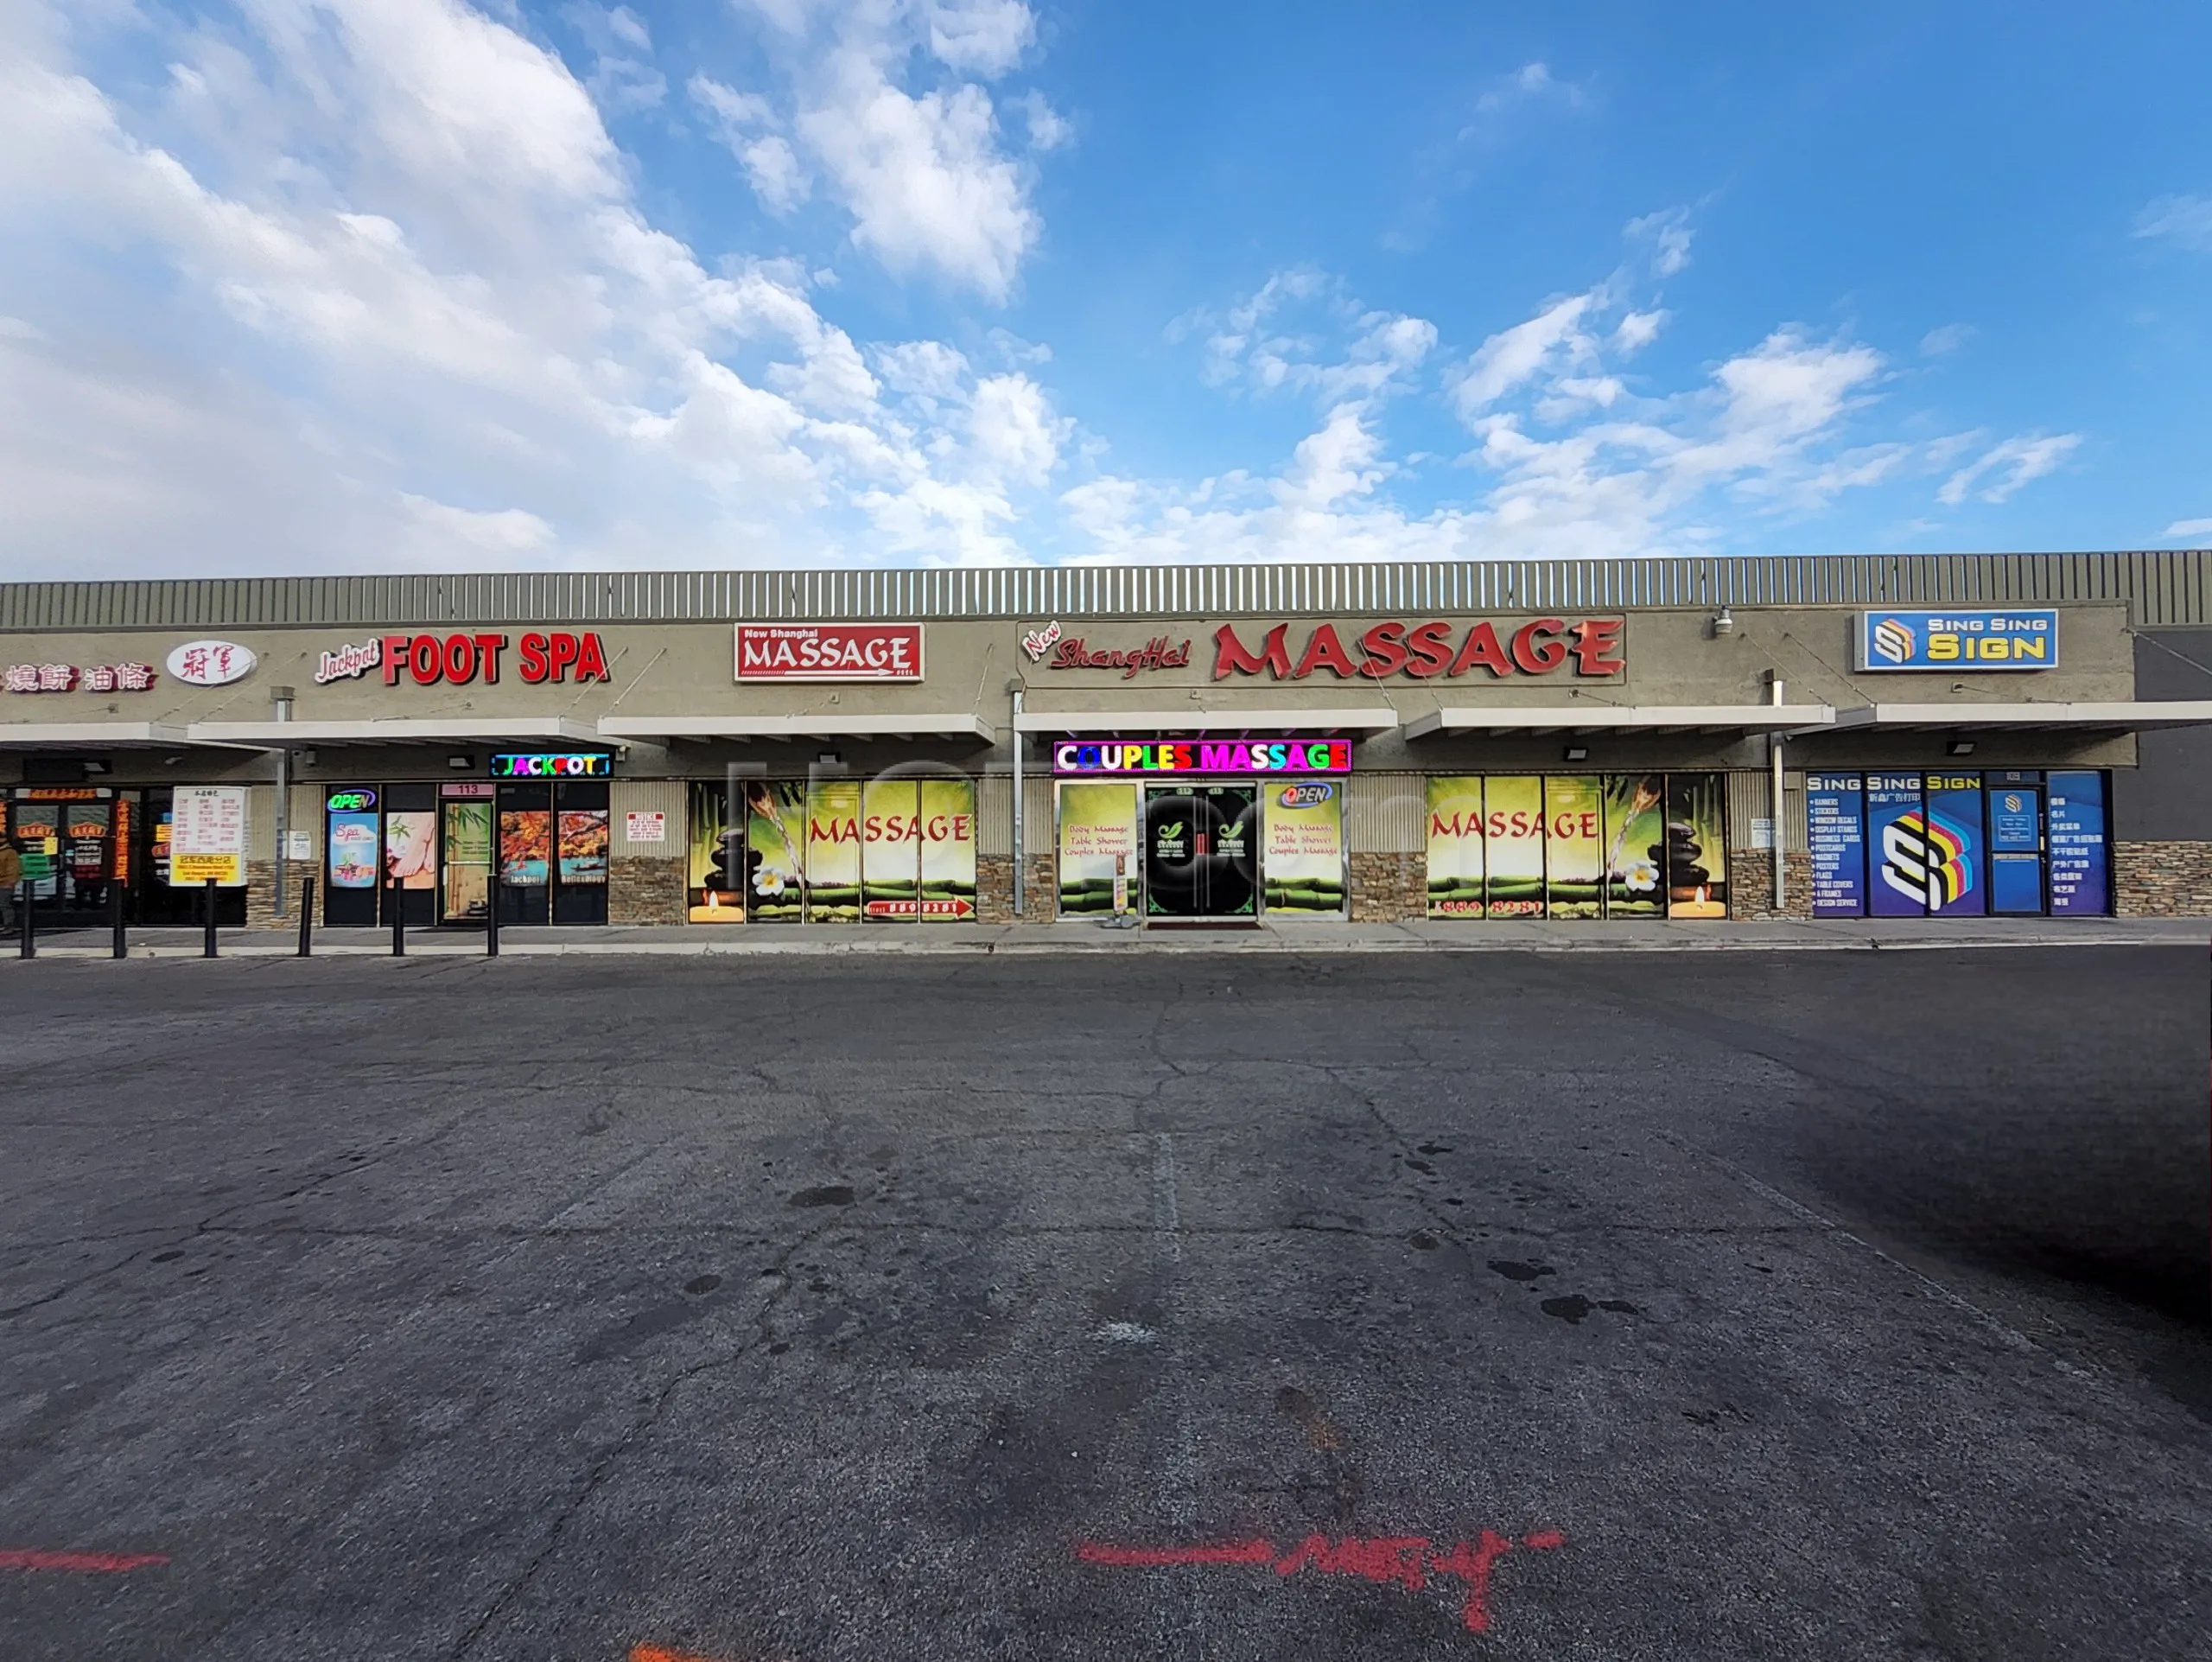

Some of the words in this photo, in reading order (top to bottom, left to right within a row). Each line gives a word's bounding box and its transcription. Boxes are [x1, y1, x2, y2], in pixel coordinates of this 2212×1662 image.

[745, 629, 768, 638] New
[770, 629, 818, 640] Shanghai
[1022, 620, 1062, 662] New
[1927, 634, 2045, 659] SIGN
[315, 639, 380, 683] Jackpot
[383, 634, 505, 685] FOOT
[518, 633, 609, 684] SPA
[744, 638, 912, 668] MASSAGE
[1213, 619, 1626, 680] MASSAGE
[504, 756, 596, 775] JACKPOT
[1057, 745, 1192, 769] COUPLES
[1201, 743, 1347, 769] MASSAGE
[330, 794, 370, 809] OPEN
[459, 785, 478, 794] 113
[1286, 786, 1326, 803] OPEN
[336, 823, 359, 842] Spa
[810, 815, 972, 844] MASSAGE
[1431, 811, 1599, 839] MASSAGE
